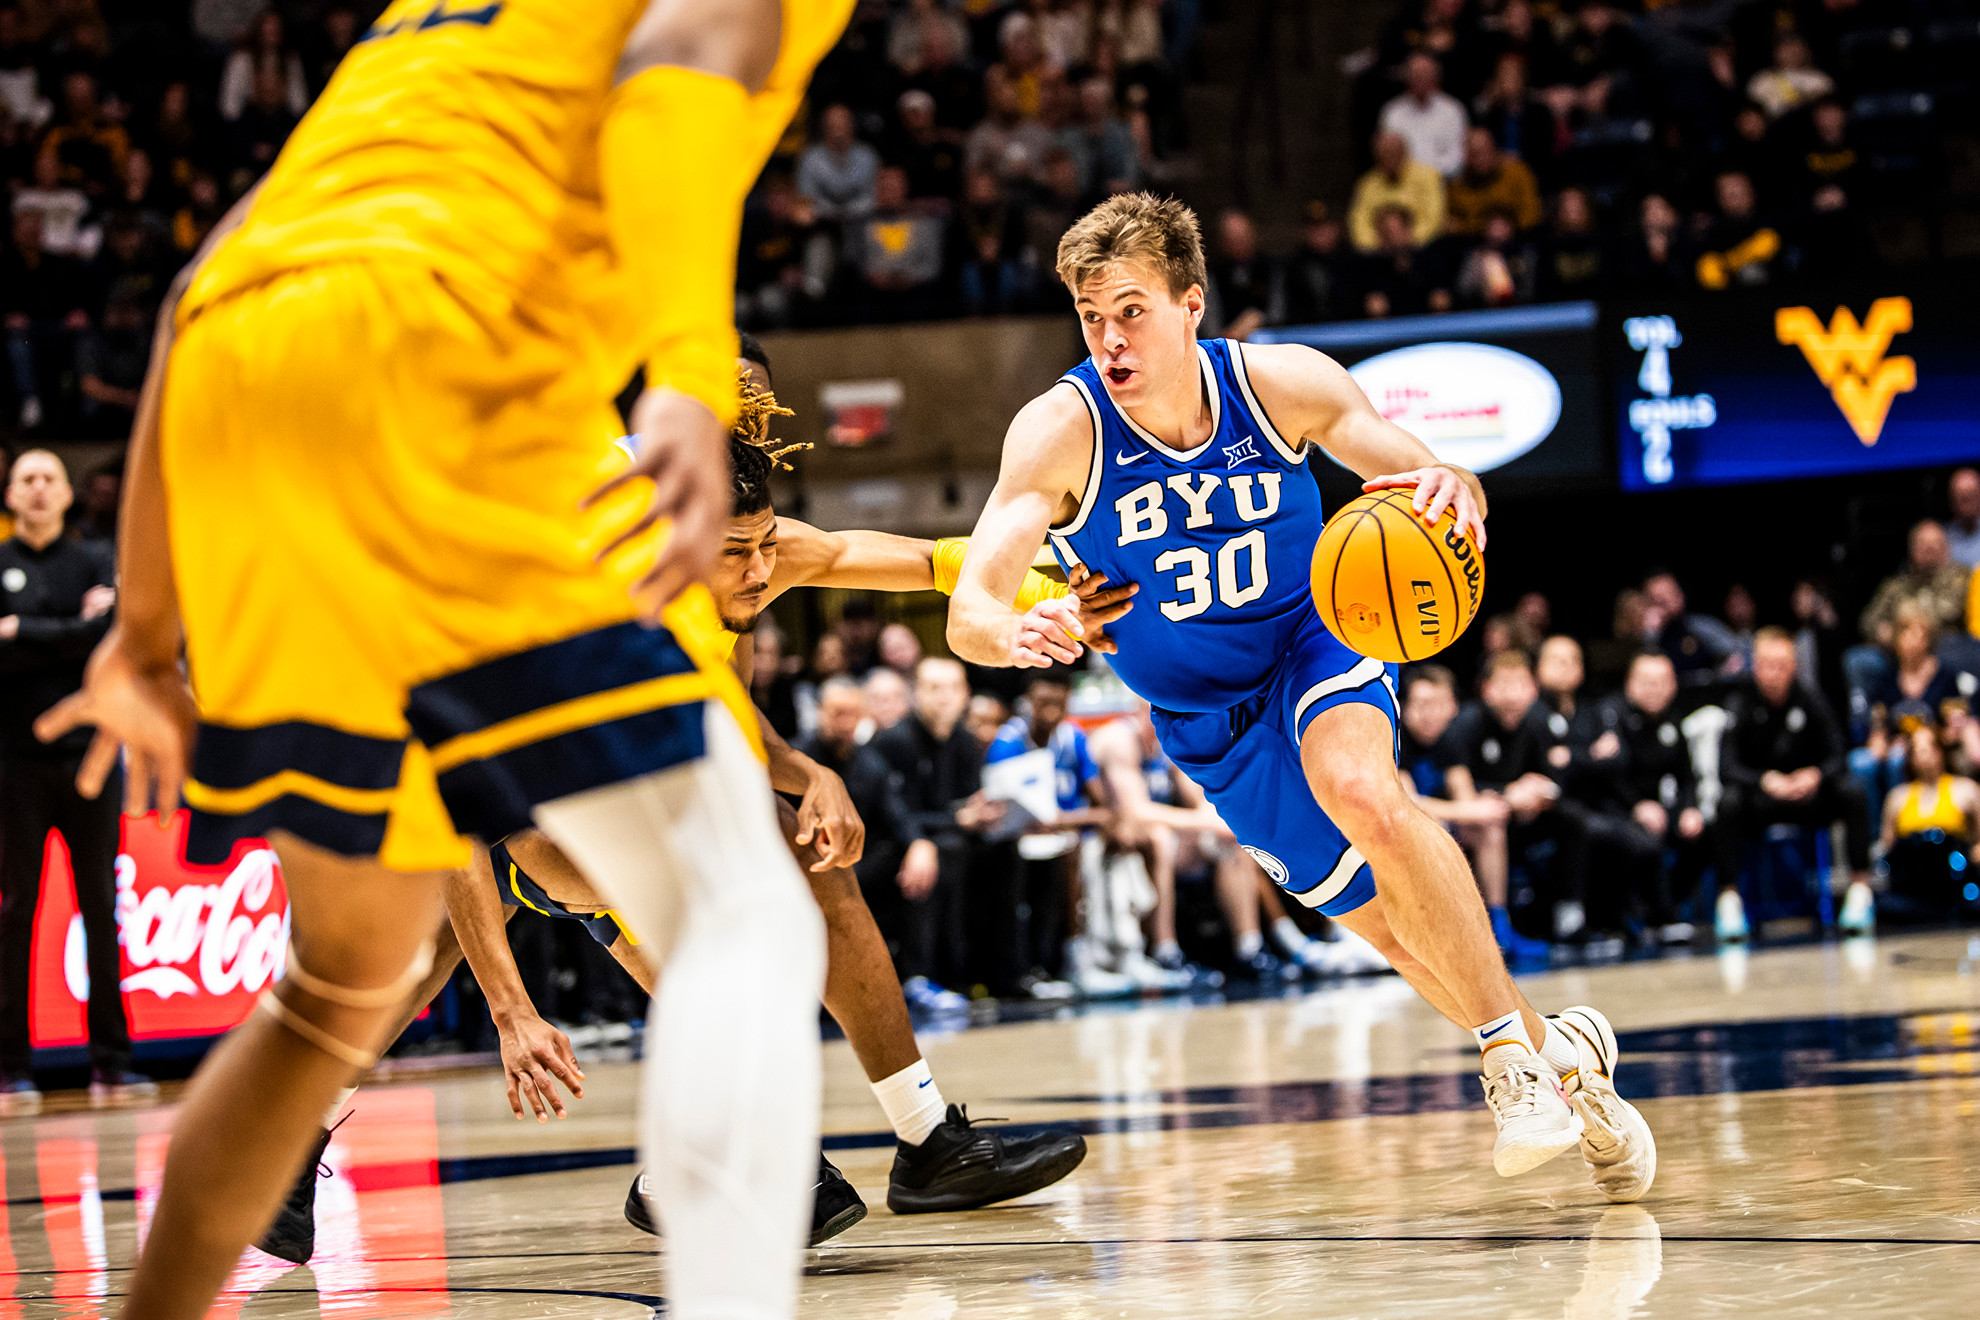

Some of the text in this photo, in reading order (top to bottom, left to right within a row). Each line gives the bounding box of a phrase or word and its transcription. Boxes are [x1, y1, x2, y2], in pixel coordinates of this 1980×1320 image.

[1114, 471, 1283, 547] BYU
[1154, 528, 1269, 622] 30
[1411, 580, 1440, 635] EVO
